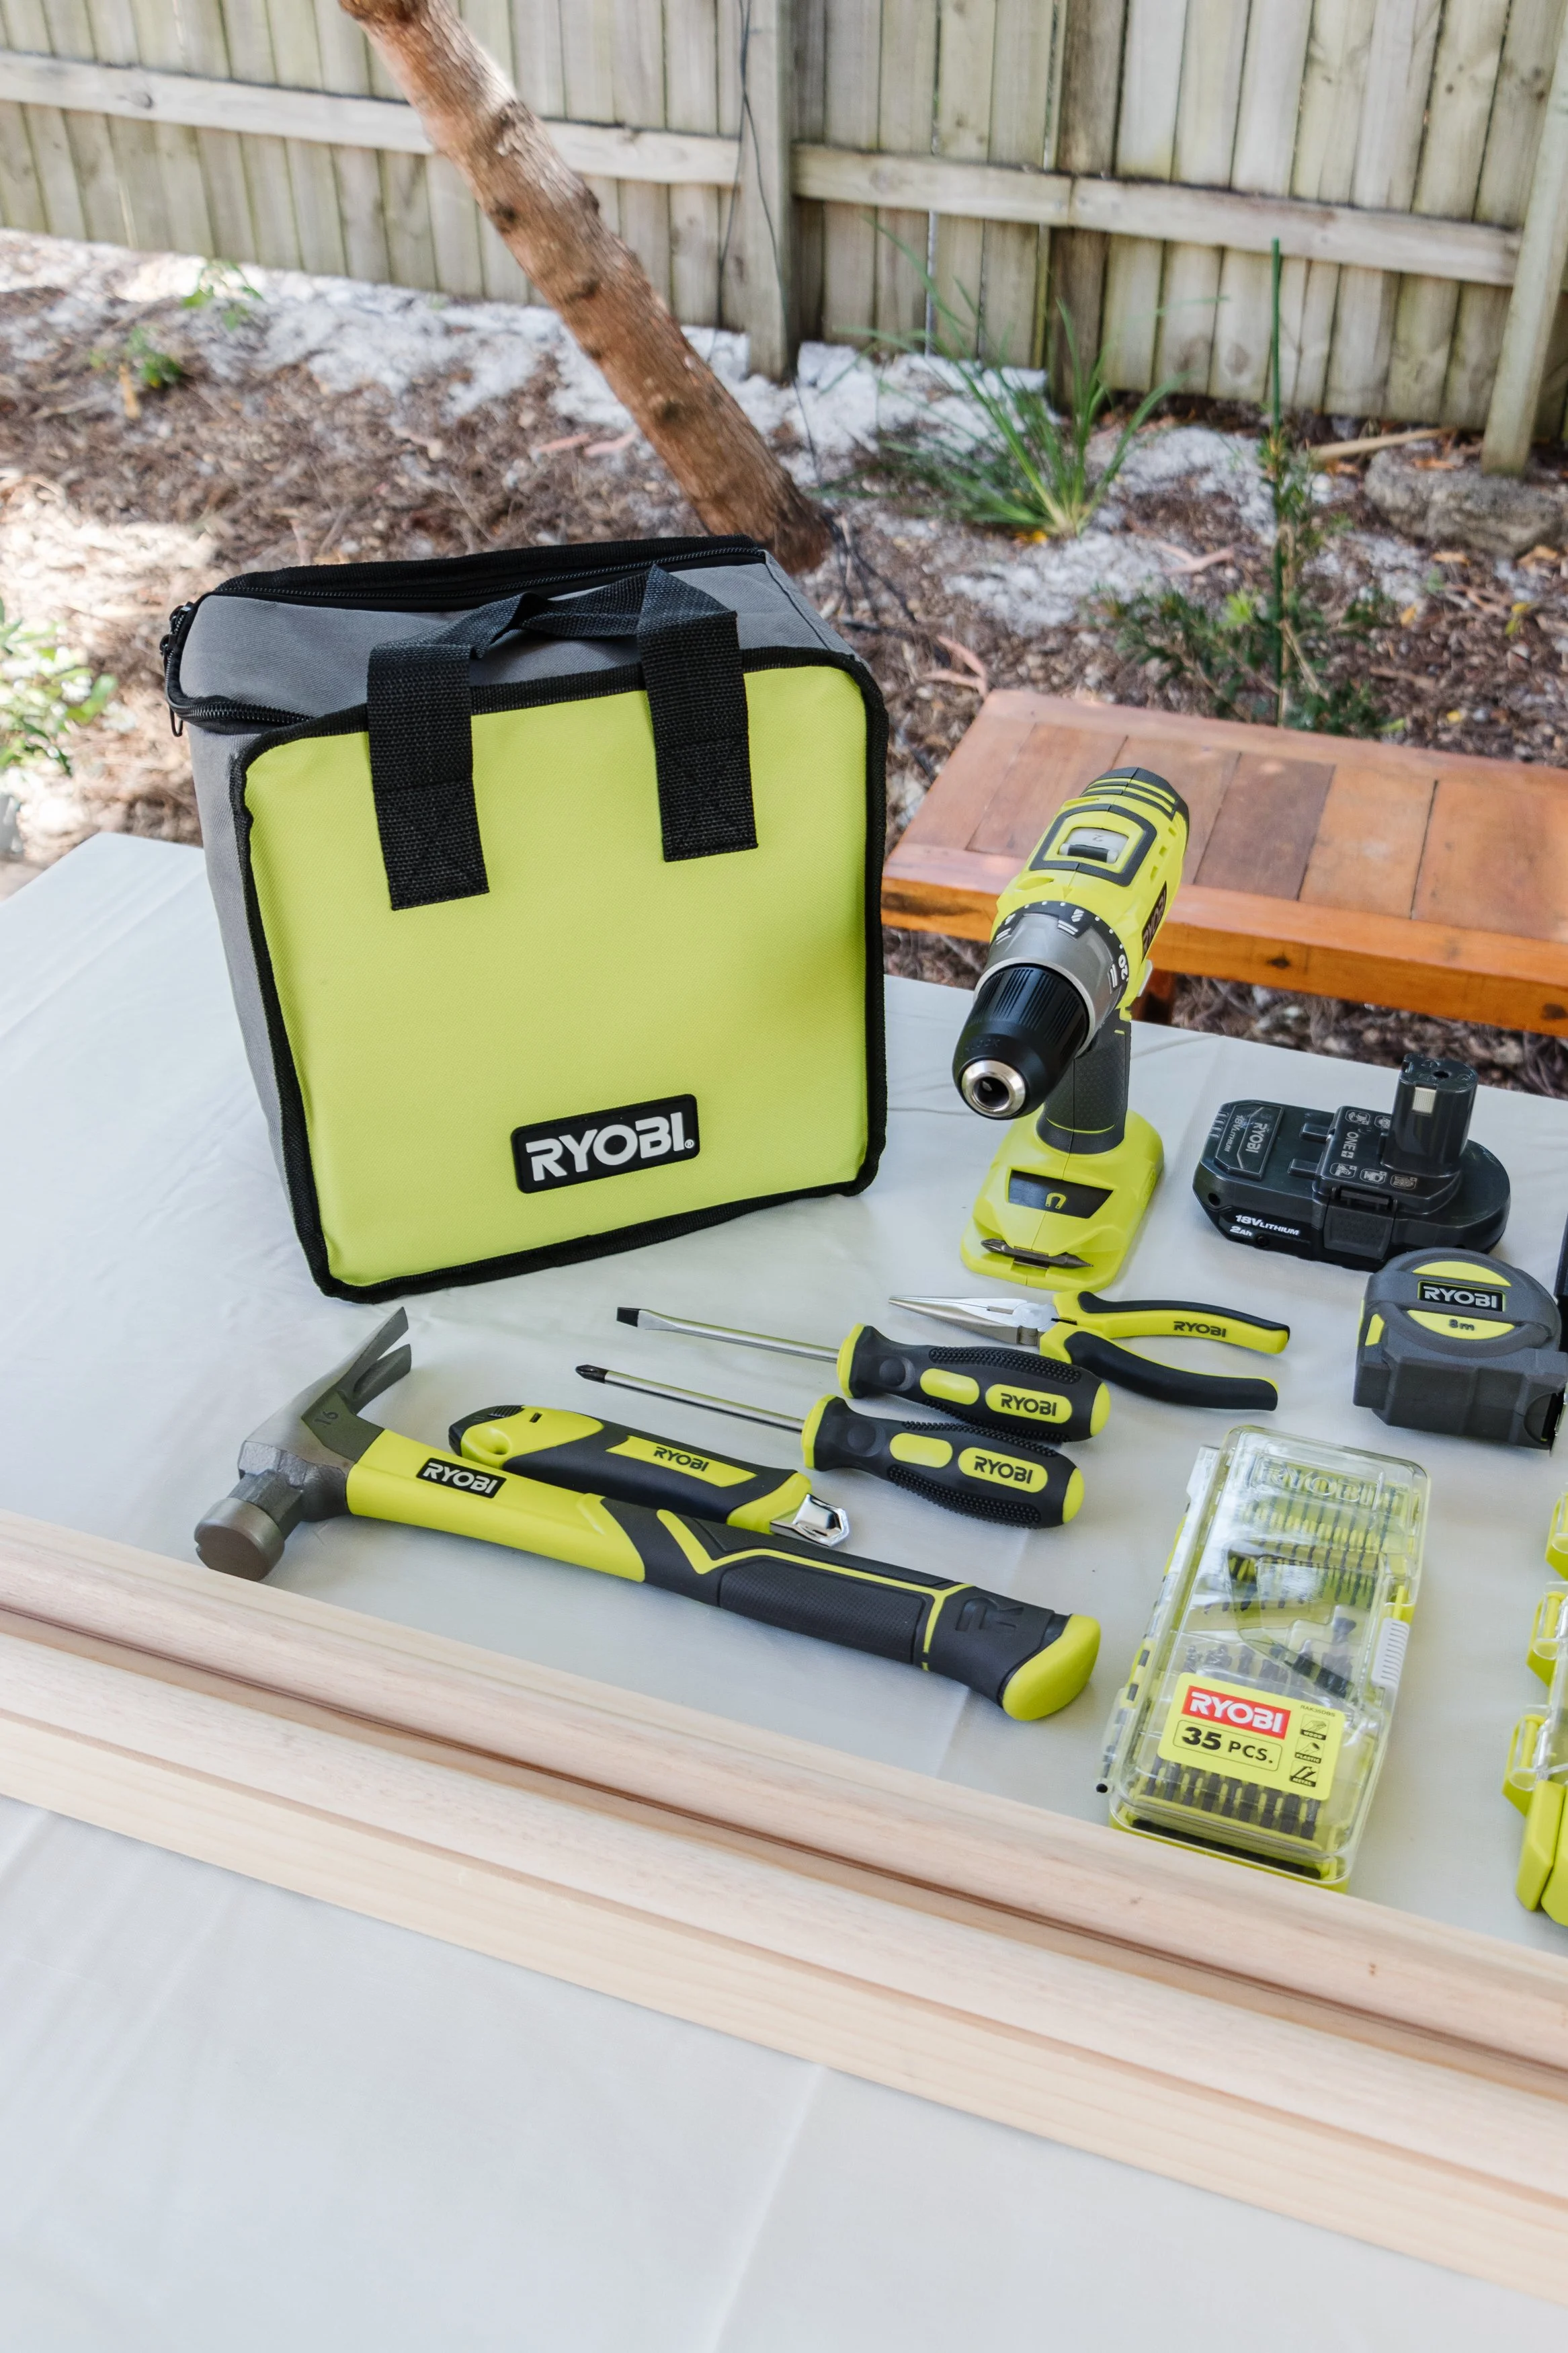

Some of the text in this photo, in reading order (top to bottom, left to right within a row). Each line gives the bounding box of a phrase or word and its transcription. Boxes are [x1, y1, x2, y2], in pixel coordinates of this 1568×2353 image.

[1245, 1122, 1268, 1153] RYOBI
[1423, 1285, 1497, 1308] RYOBI
[1173, 1320, 1227, 1338] RYOBI
[1000, 1392, 1057, 1417] RYOBI
[653, 1446, 710, 1472] RYOBI
[973, 1455, 1033, 1484] RYOBI
[422, 1462, 498, 1494] RYOBI
[1190, 1691, 1284, 1734] RYOBI
[1181, 1726, 1274, 1764] 35 PCS.
[1303, 1730, 1323, 1739] WOOD
